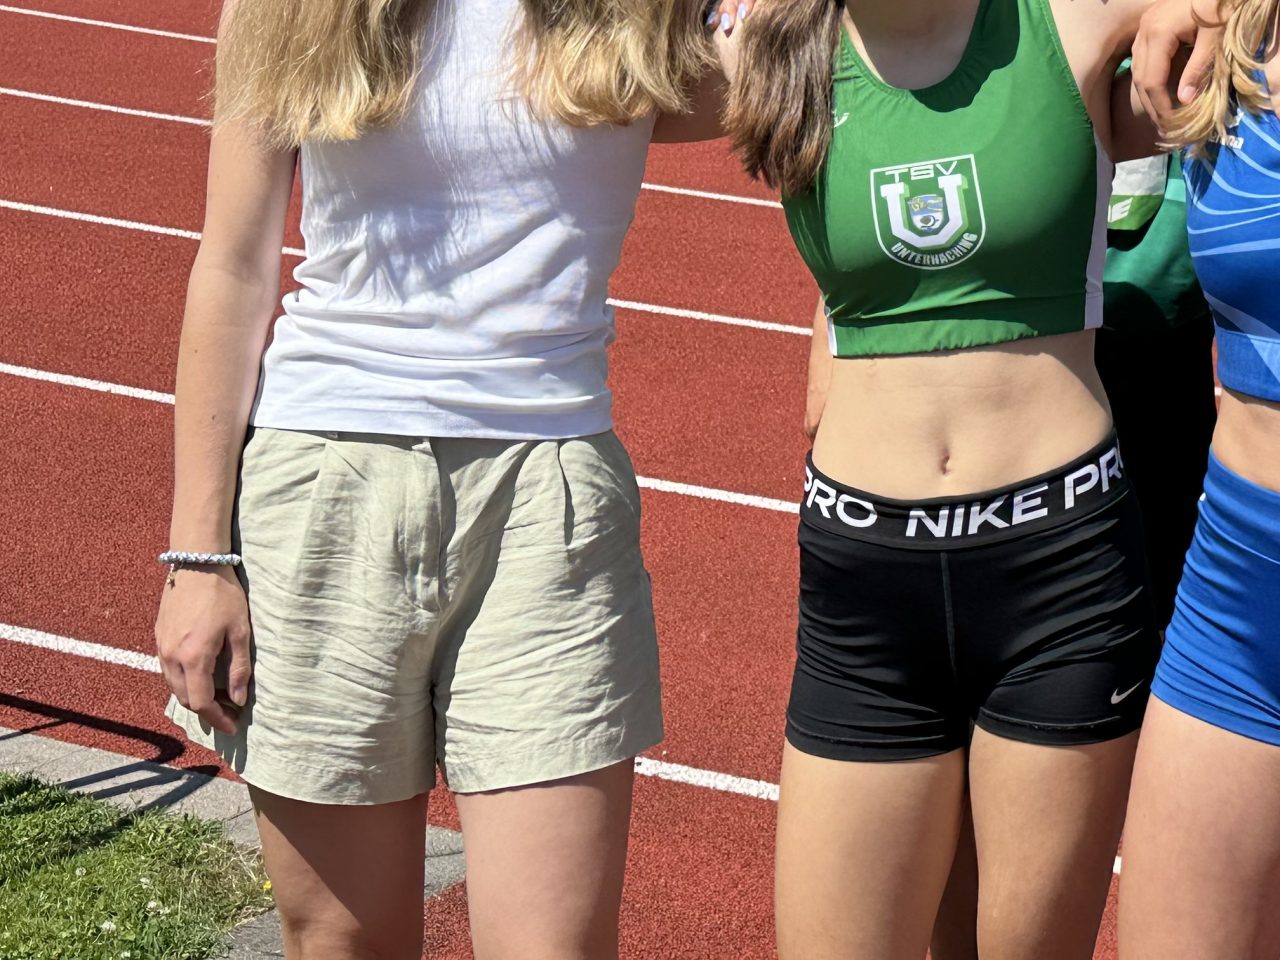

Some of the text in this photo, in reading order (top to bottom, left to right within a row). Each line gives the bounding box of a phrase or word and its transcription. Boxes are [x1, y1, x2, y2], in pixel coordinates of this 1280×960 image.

[884, 160, 958, 184] TSV
[905, 483, 1049, 538] NIKE
[1064, 438, 1125, 510] PR
